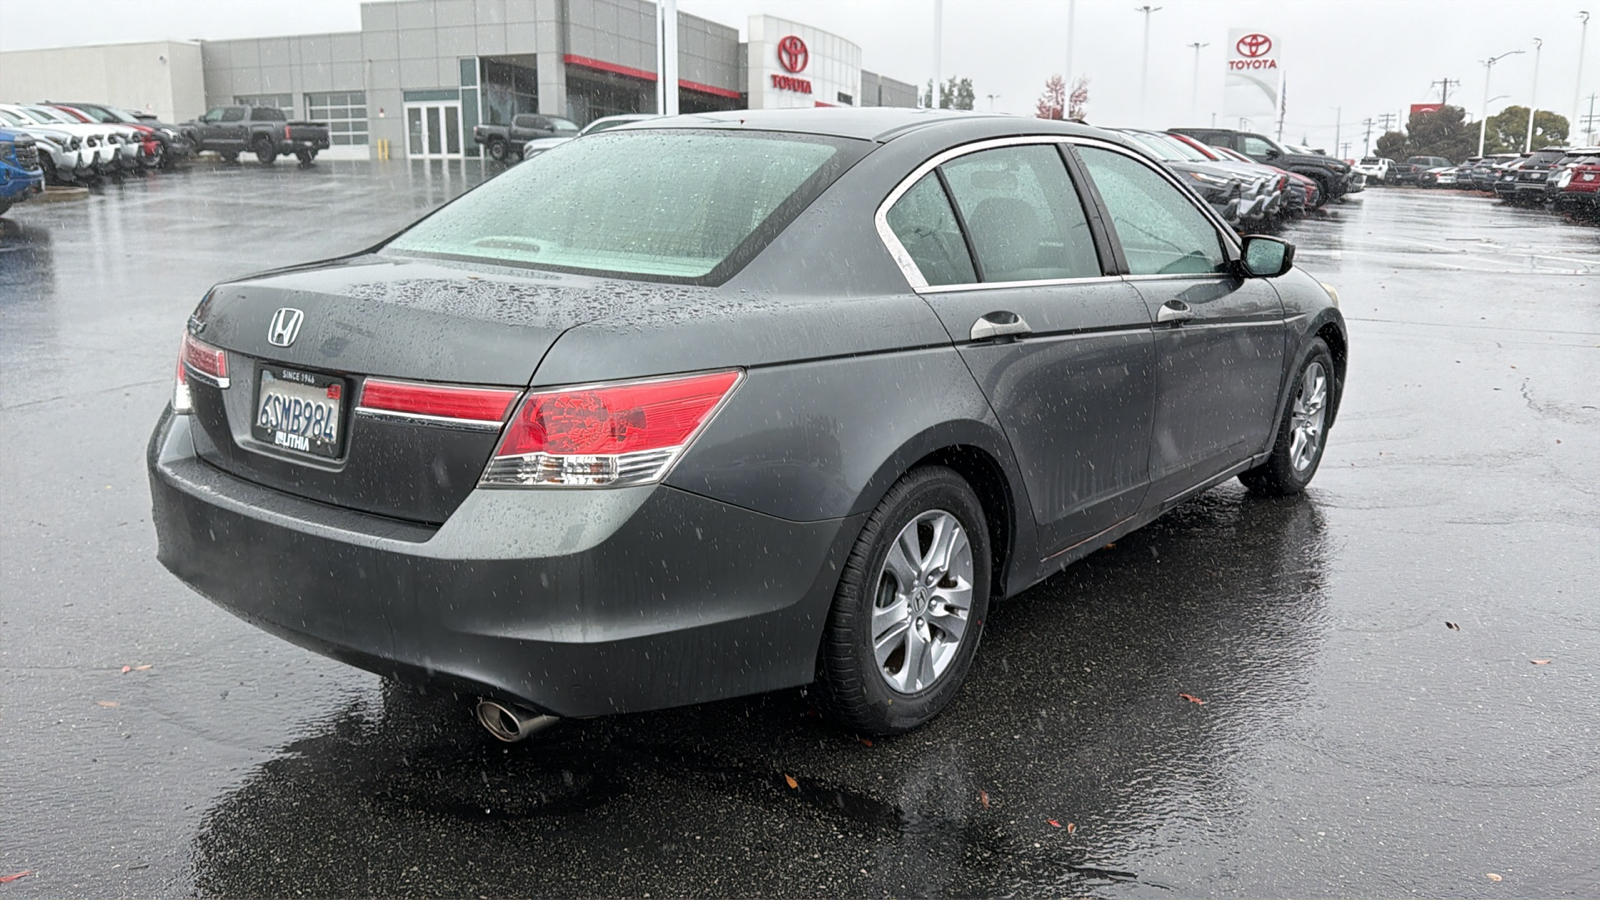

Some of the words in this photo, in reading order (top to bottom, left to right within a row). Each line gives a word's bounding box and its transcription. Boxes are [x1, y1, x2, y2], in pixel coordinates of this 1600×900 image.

[1229, 59, 1277, 70] TOYOTA
[771, 74, 812, 94] TOYOTA
[282, 370, 300, 382] SINCE
[301, 373, 315, 384] 1946
[260, 392, 334, 440] 6SMB984
[282, 432, 310, 452] LITHIA
